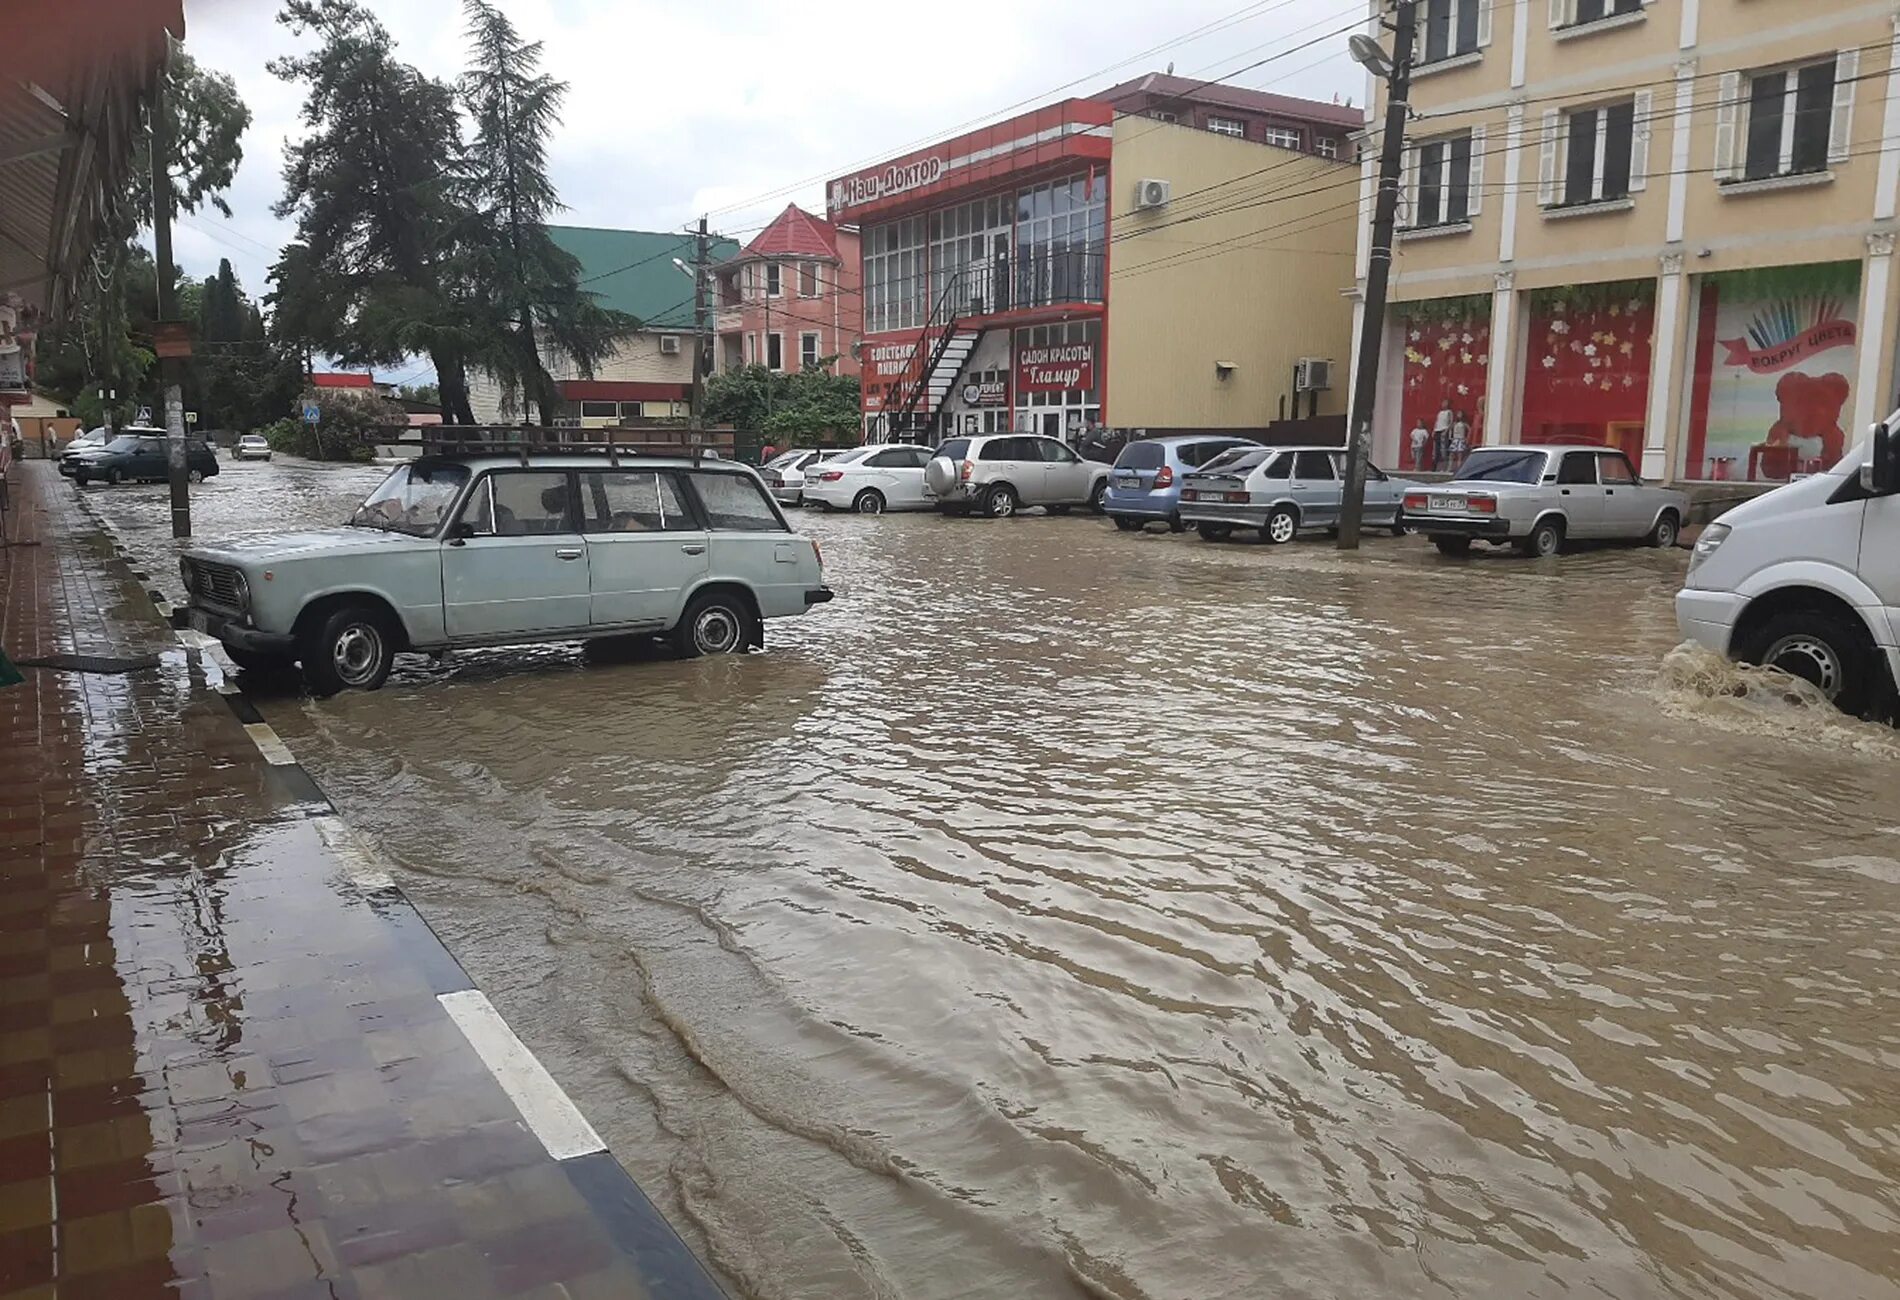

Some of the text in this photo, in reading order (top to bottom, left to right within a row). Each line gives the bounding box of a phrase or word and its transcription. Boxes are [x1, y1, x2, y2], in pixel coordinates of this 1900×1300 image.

[847, 157, 940, 204] Наш Доктор
[1021, 345, 1091, 365] САЛОН КРАСОТЫ
[1751, 326, 1852, 368] ВОКРУГ ЦВЕТА
